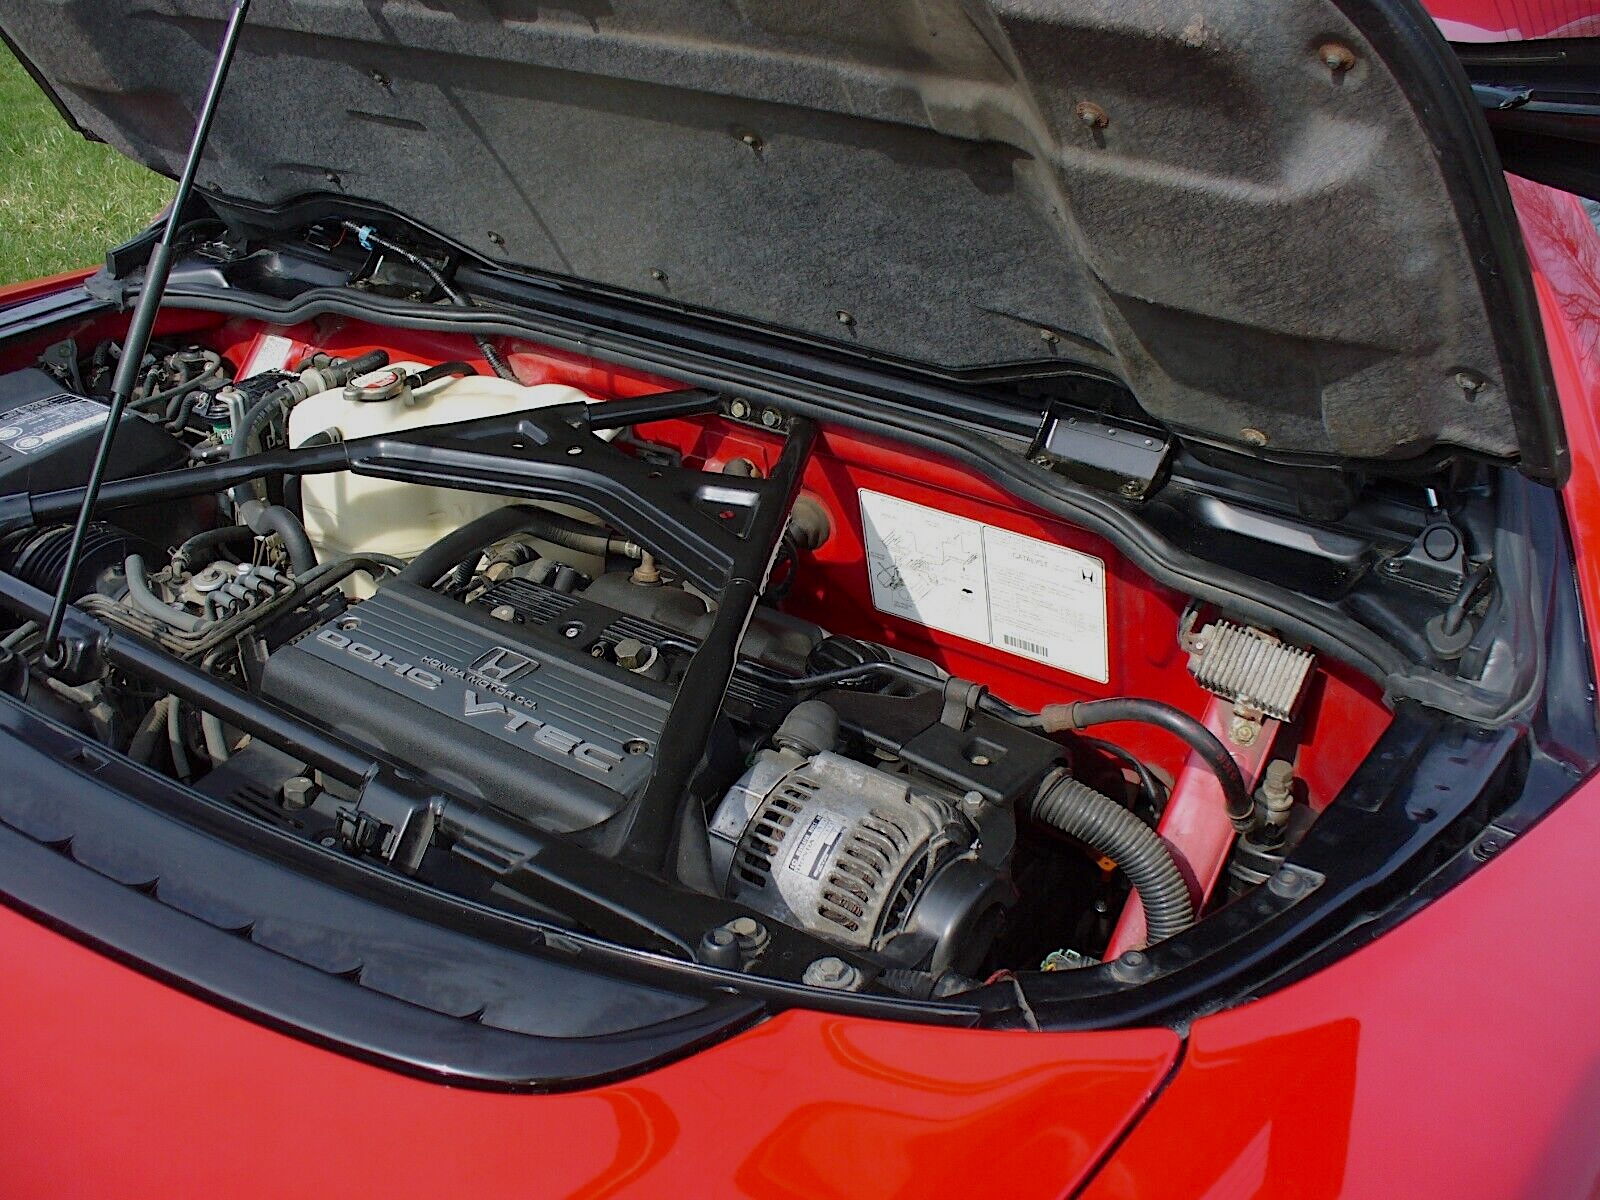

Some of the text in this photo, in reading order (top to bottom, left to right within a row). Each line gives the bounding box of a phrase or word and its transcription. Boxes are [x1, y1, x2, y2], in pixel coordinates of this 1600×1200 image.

[316, 629, 444, 690] DOHC
[421, 655, 468, 680] HONDA
[467, 675, 518, 702] MOTOR
[464, 690, 624, 773] VTEC
